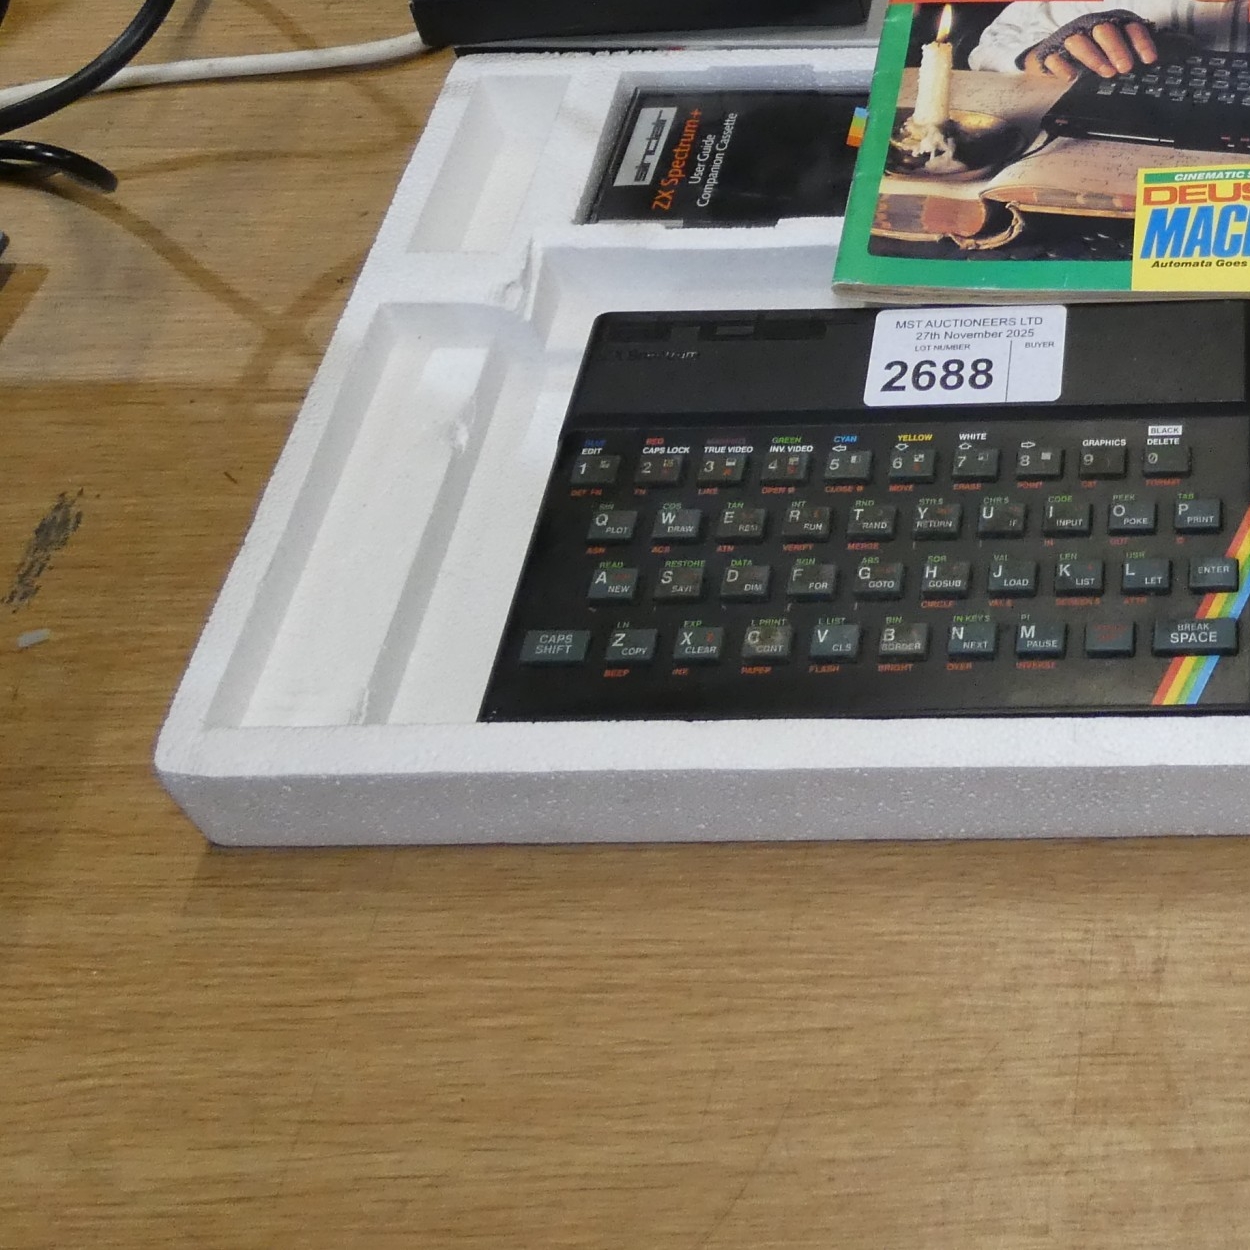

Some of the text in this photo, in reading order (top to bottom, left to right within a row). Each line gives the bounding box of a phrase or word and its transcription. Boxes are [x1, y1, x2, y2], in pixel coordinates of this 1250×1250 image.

[634, 110, 667, 182] sinclair
[653, 108, 702, 211] ZX Spectrum+
[688, 134, 716, 185] User Guide
[697, 112, 738, 208] Companion Cassette
[1174, 171, 1245, 181] CINEMATIC
[1151, 260, 1212, 268] Automata
[1216, 259, 1247, 267] Goes
[896, 317, 1043, 329] MST AUCTIONEERS LTD
[916, 329, 1035, 340] 27th November 2025
[1025, 341, 1054, 349] BUYER
[880, 358, 994, 392] 2688
[662, 512, 675, 524] W
[916, 520, 952, 528] RETURN
[925, 566, 938, 578] H
[1059, 564, 1071, 577] K
[1125, 563, 1135, 576] L
[595, 571, 607, 584] A
[1076, 578, 1095, 586] LIST
[817, 630, 829, 642] V
[952, 626, 964, 640] N
[1020, 625, 1036, 639] M
[1170, 632, 1217, 644] SPACE
[539, 635, 573, 643] CAPS
[1027, 640, 1058, 648] PAUSE
[535, 645, 572, 654] SHIFT
[621, 647, 647, 655] COPY
